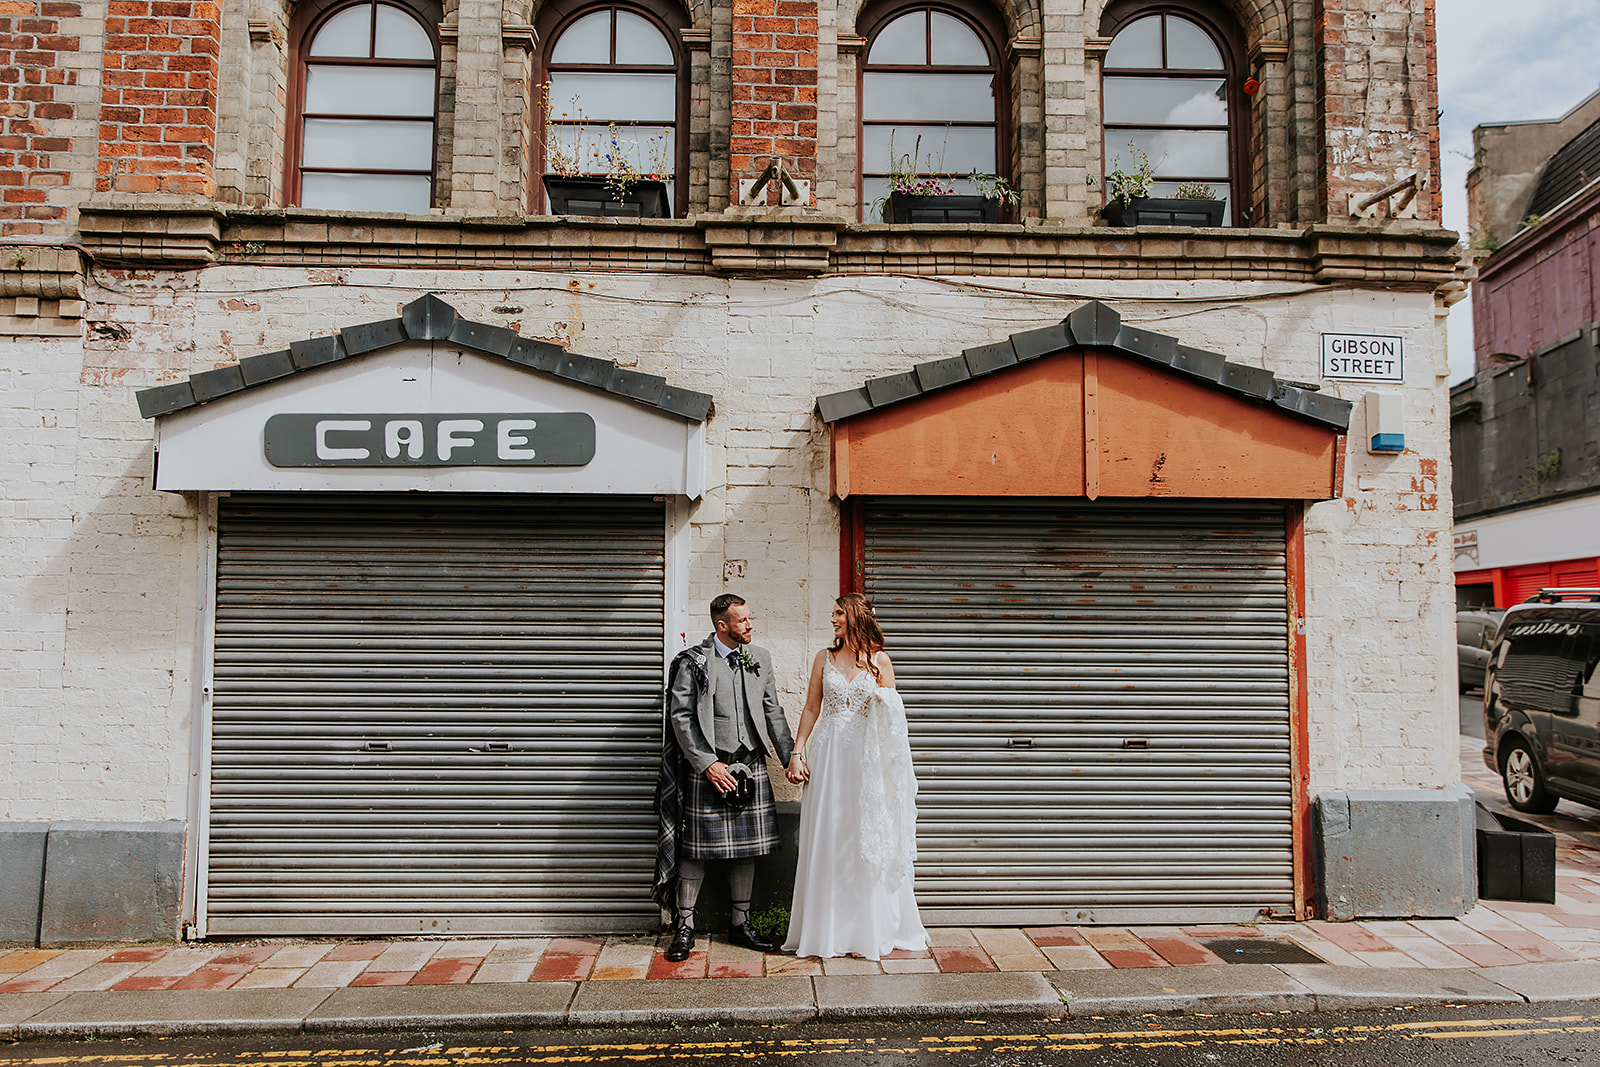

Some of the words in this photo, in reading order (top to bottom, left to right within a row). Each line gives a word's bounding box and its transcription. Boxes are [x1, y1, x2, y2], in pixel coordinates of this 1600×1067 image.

[1331, 339, 1394, 356] GIBSON
[1330, 358, 1395, 374] STREET
[315, 419, 537, 461] CAFE
